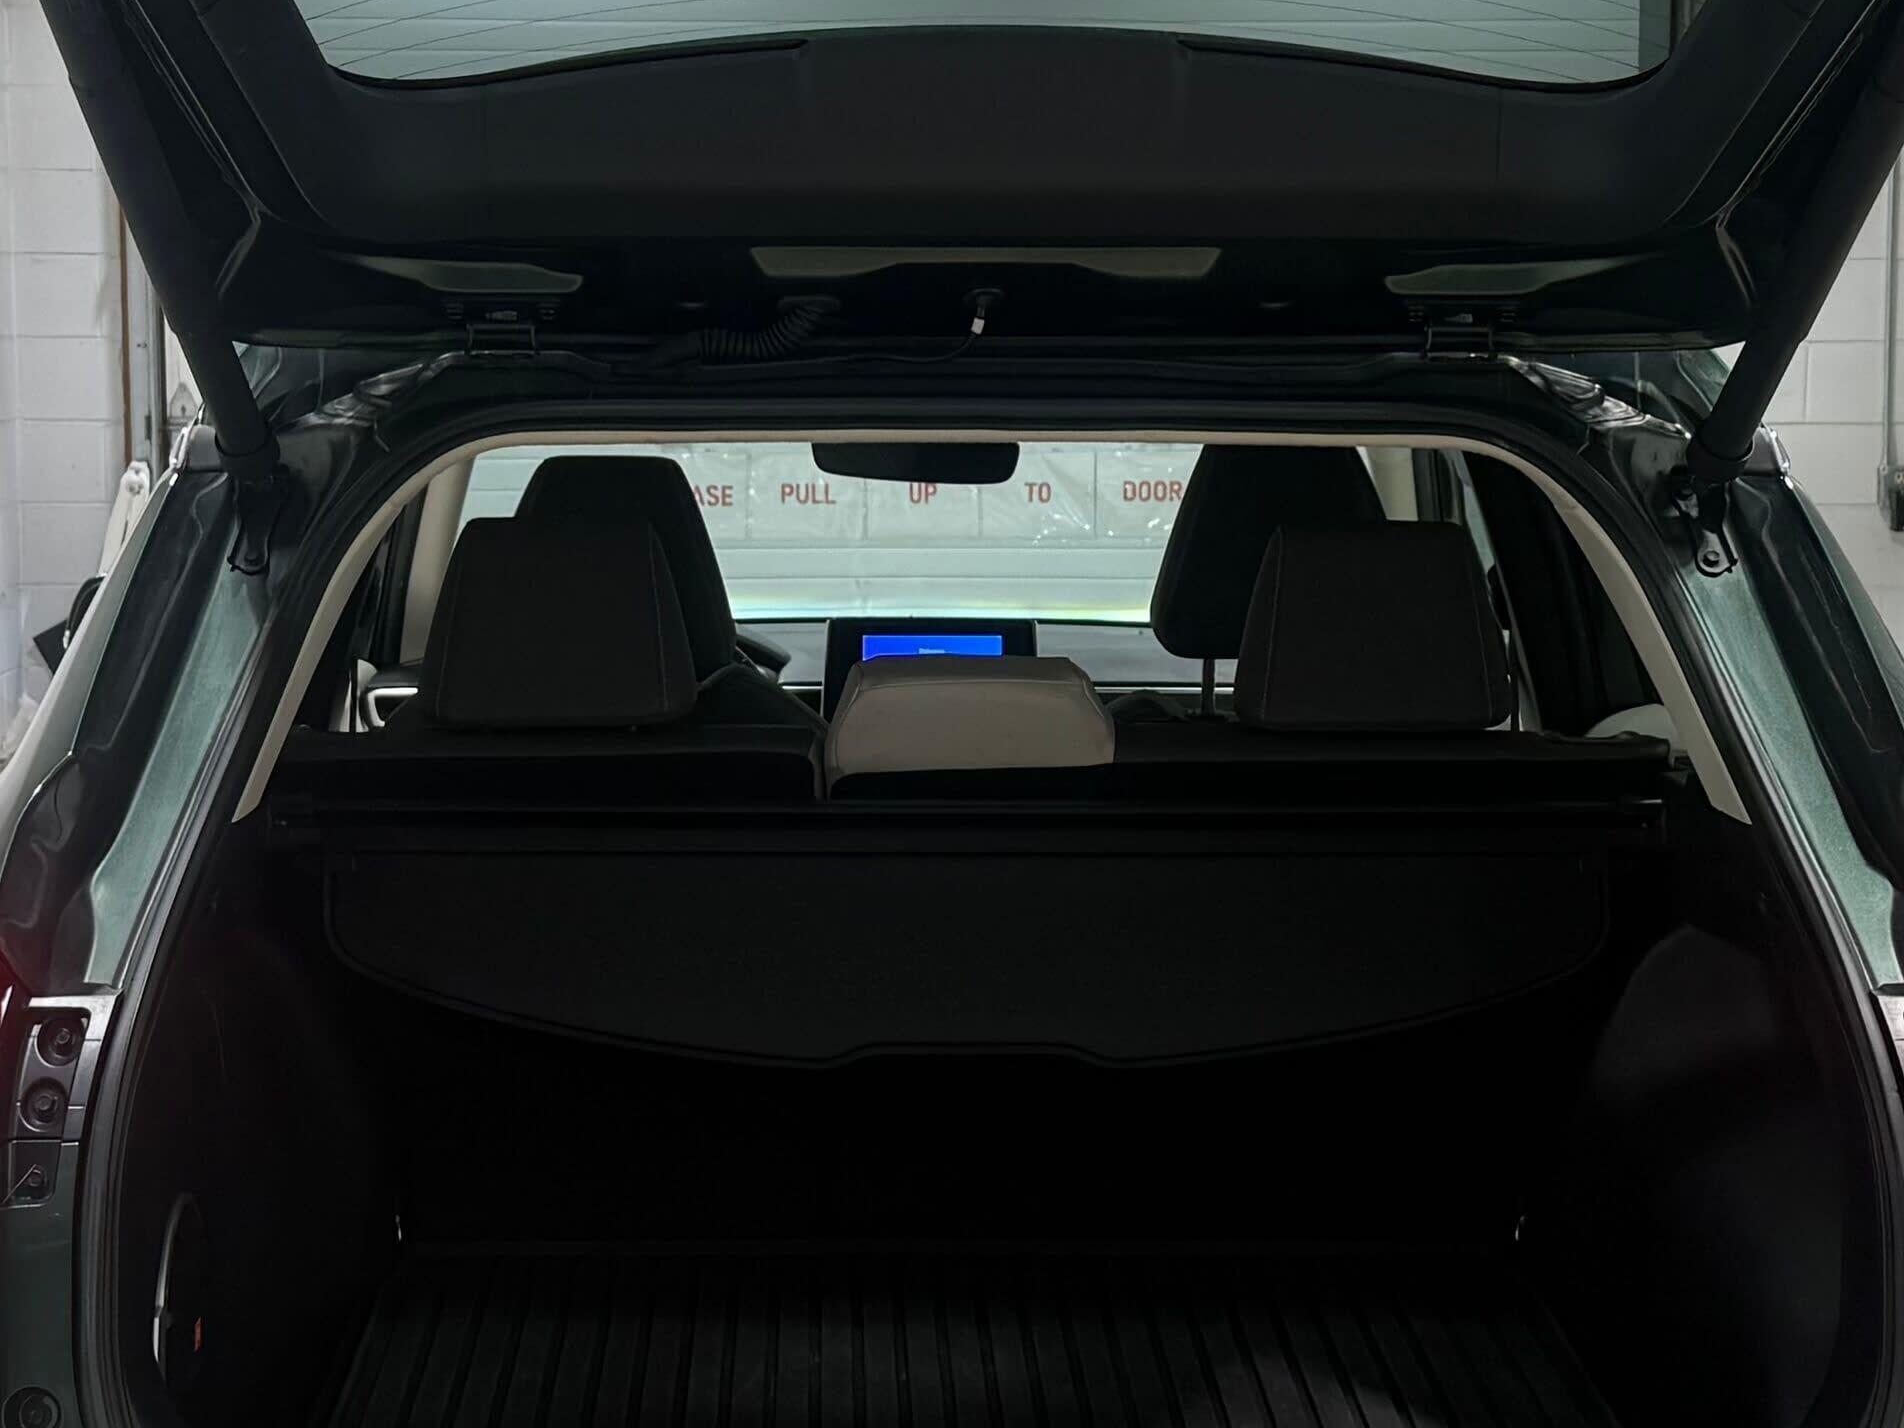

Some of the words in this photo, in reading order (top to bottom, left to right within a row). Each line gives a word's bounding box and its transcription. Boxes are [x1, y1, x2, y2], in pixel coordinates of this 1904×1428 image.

[693, 484, 734, 507] ASE
[780, 483, 836, 504] PULL
[908, 482, 938, 504] UP
[1024, 482, 1052, 503] TO
[1122, 481, 1183, 502] DOOR
